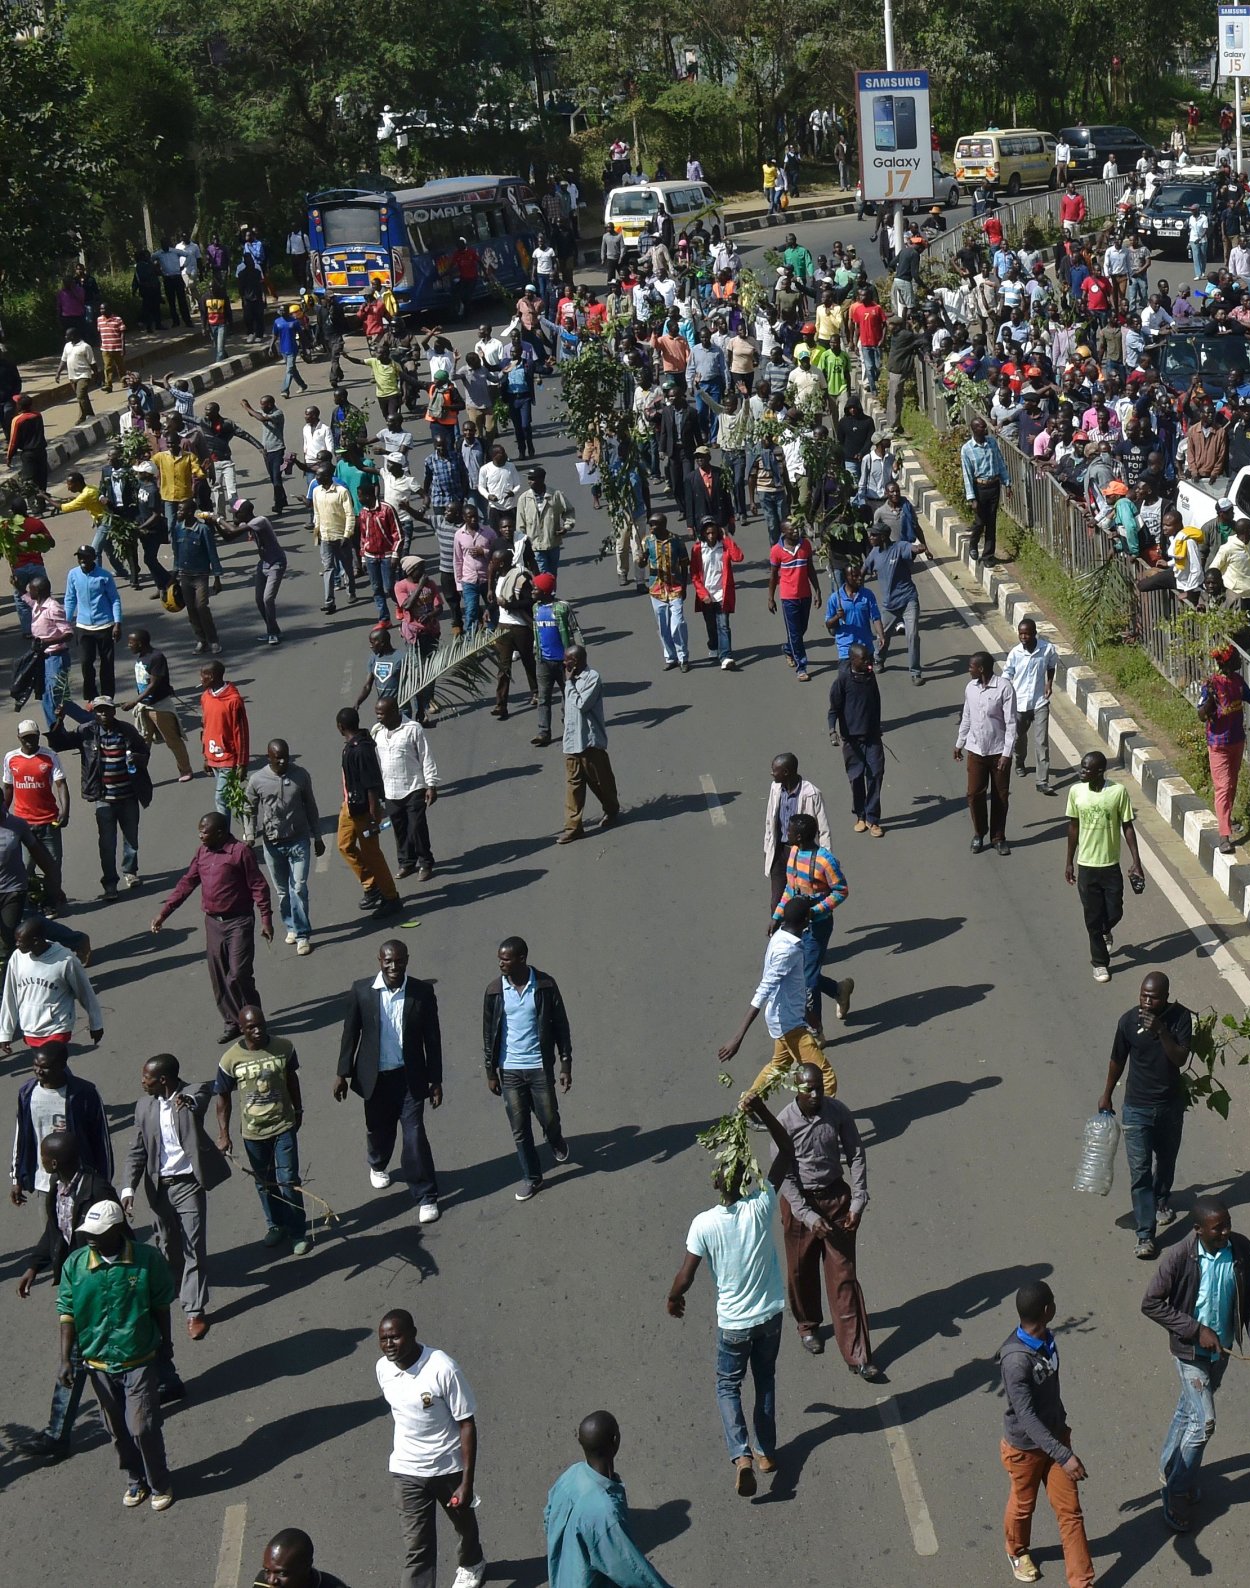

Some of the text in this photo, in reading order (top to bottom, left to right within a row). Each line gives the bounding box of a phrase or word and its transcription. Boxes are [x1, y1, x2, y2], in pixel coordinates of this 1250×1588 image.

[1223, 51, 1246, 59] Galaxy
[1229, 59, 1242, 73] J5
[865, 77, 921, 88] SAMSUNG
[873, 156, 921, 171] Galaxy
[885, 169, 912, 197] J7
[864, 312, 870, 320] 7
[16, 781, 45, 789] Emirates
[22, 976, 55, 990] ALL STAR
